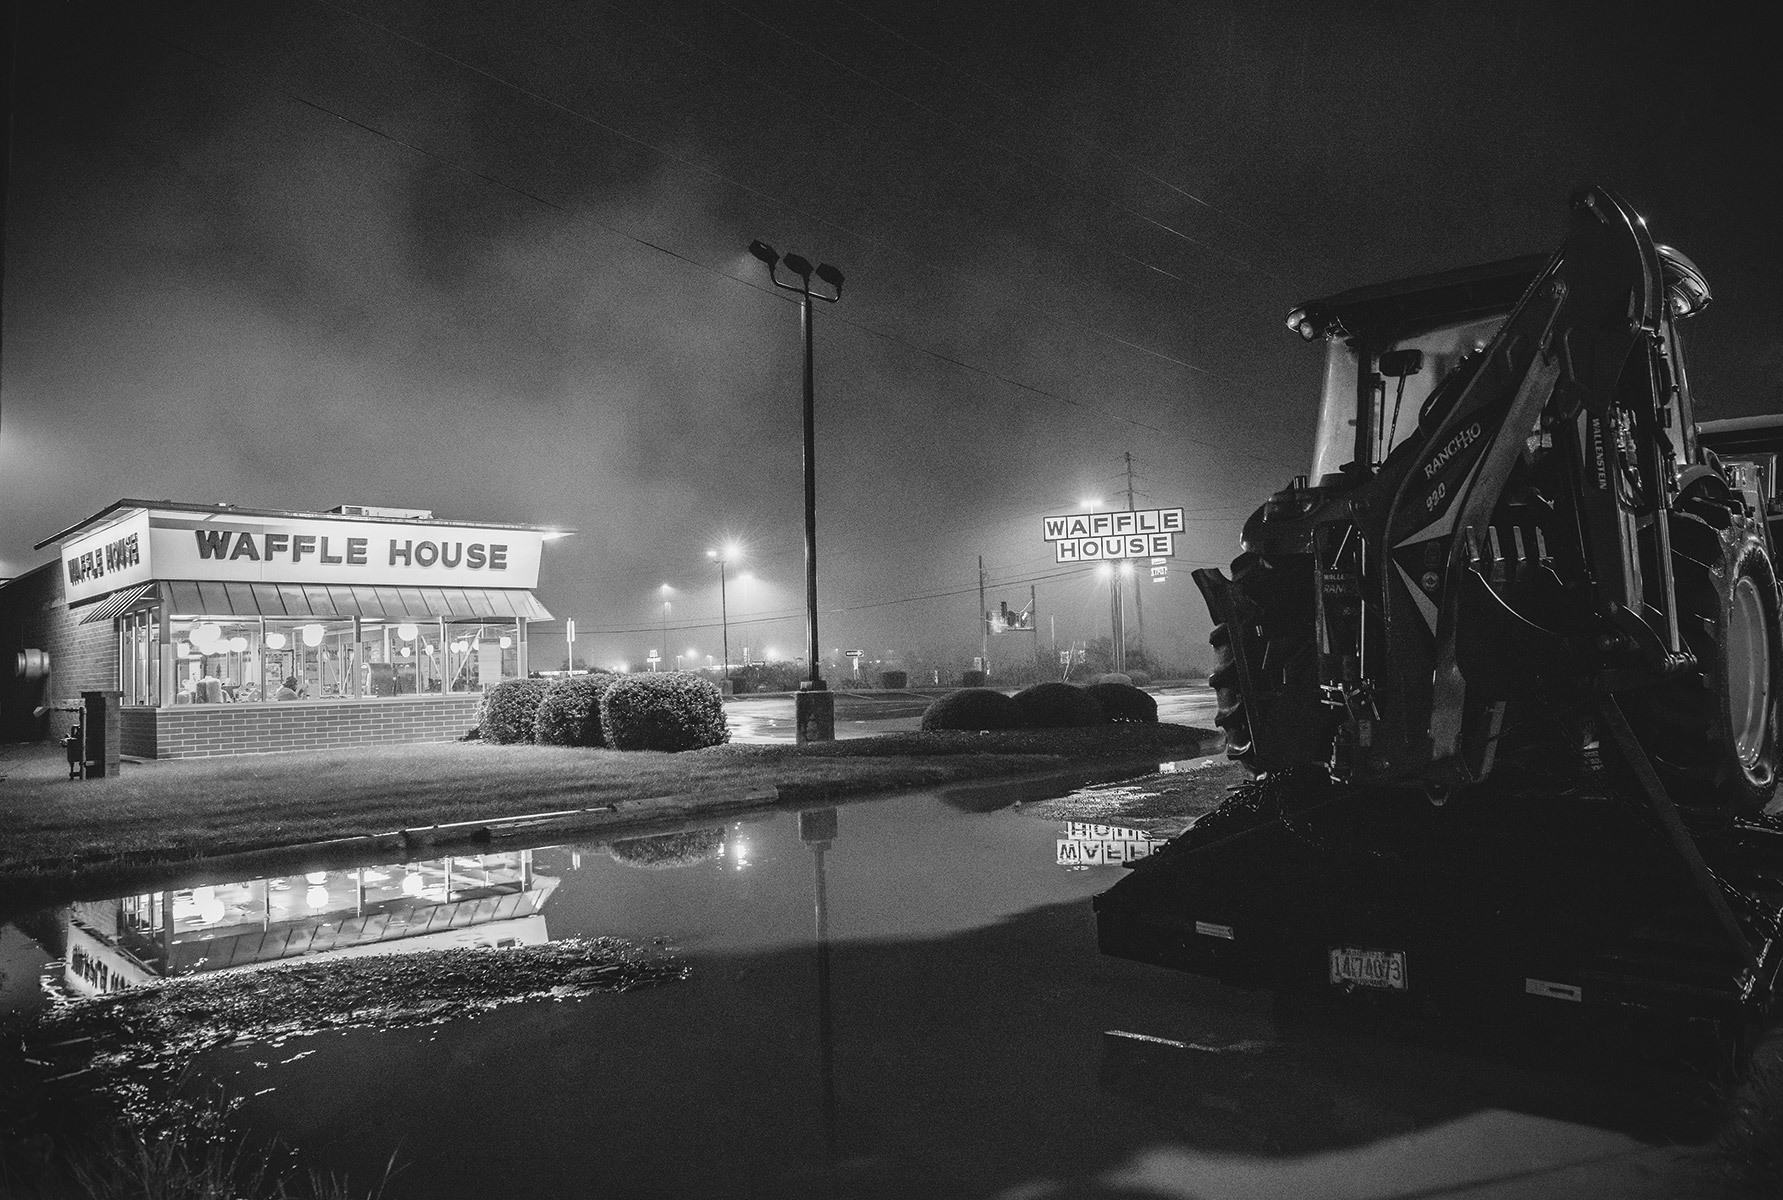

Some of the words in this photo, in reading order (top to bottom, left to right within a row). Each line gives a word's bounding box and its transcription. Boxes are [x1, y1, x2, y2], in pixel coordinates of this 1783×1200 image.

[1592, 418, 1607, 490] WALLENSTEIN
[1046, 512, 1179, 536] WAFFLE
[67, 547, 104, 587] WAFFLE
[105, 532, 140, 574] HOUSE
[195, 529, 368, 565] WAFFLE
[388, 539, 508, 569] HOUSE
[1060, 536, 1168, 558] HOUSE
